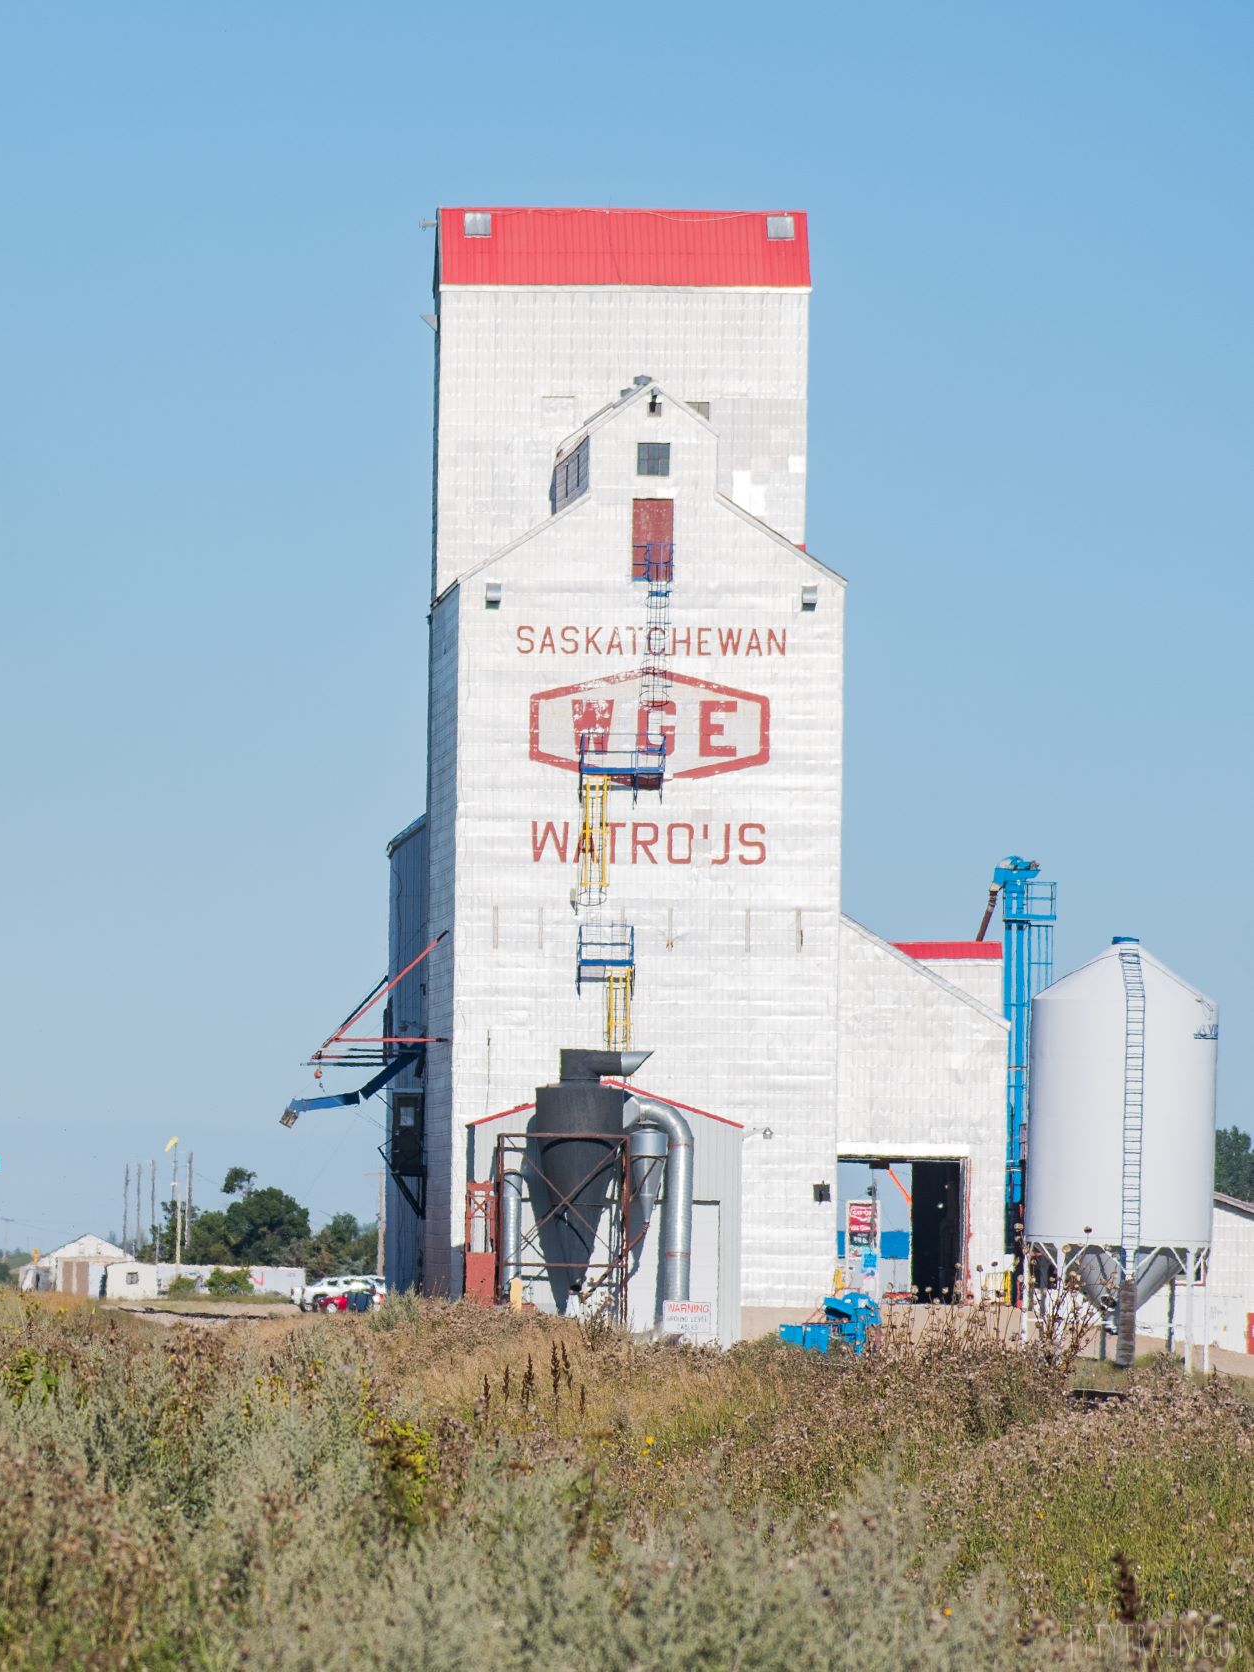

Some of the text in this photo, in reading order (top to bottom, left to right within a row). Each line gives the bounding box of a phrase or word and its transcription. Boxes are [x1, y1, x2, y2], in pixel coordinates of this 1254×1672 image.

[516, 625, 787, 657] SASKATCHEWAN
[571, 699, 738, 757] WGE
[666, 1303, 710, 1313] WARNING
